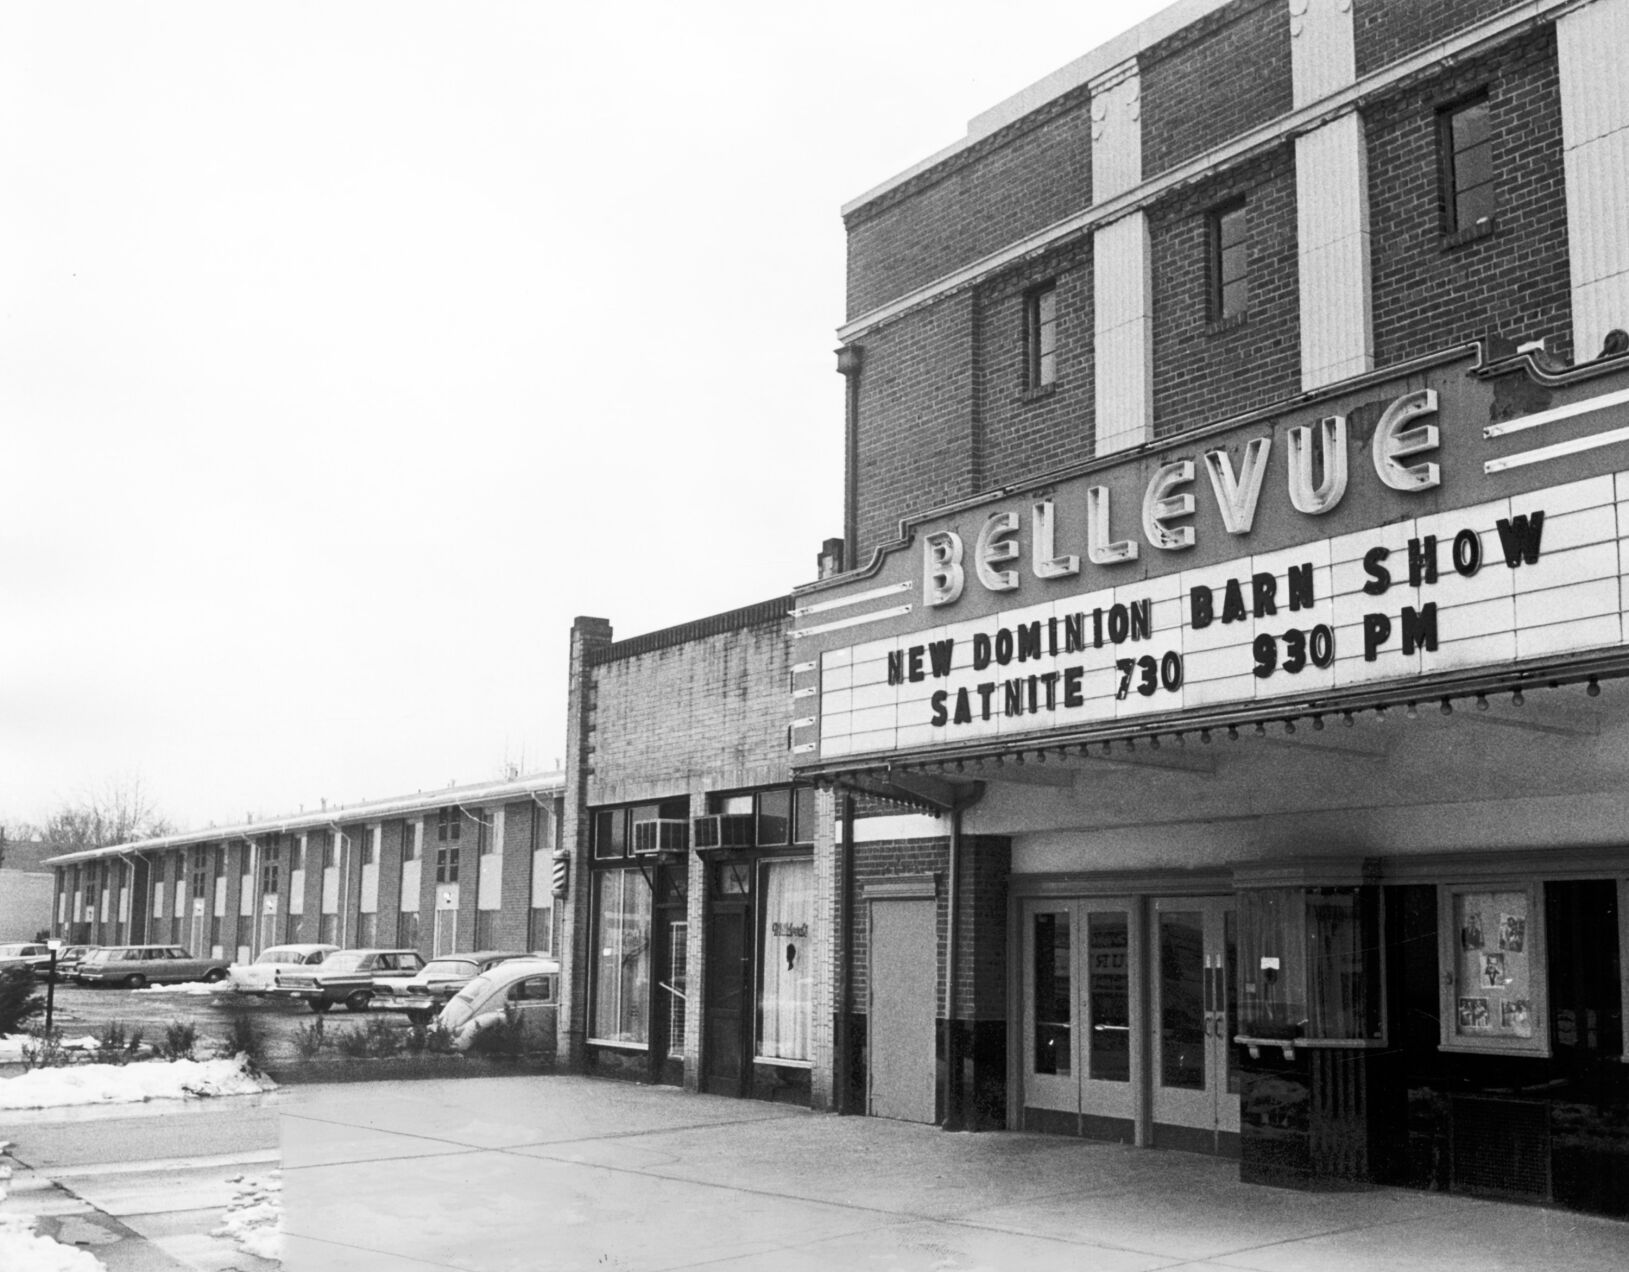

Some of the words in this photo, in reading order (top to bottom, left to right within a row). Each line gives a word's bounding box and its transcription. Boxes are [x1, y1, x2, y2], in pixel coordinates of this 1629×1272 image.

[923, 389, 1441, 607] BELLEVUE
[888, 638, 954, 686] NEW
[973, 598, 1152, 670] DOMINION
[1190, 562, 1314, 630] BARN
[1362, 510, 1545, 596] SHOW
[1115, 650, 1184, 701] 730
[1252, 623, 1335, 679] 930
